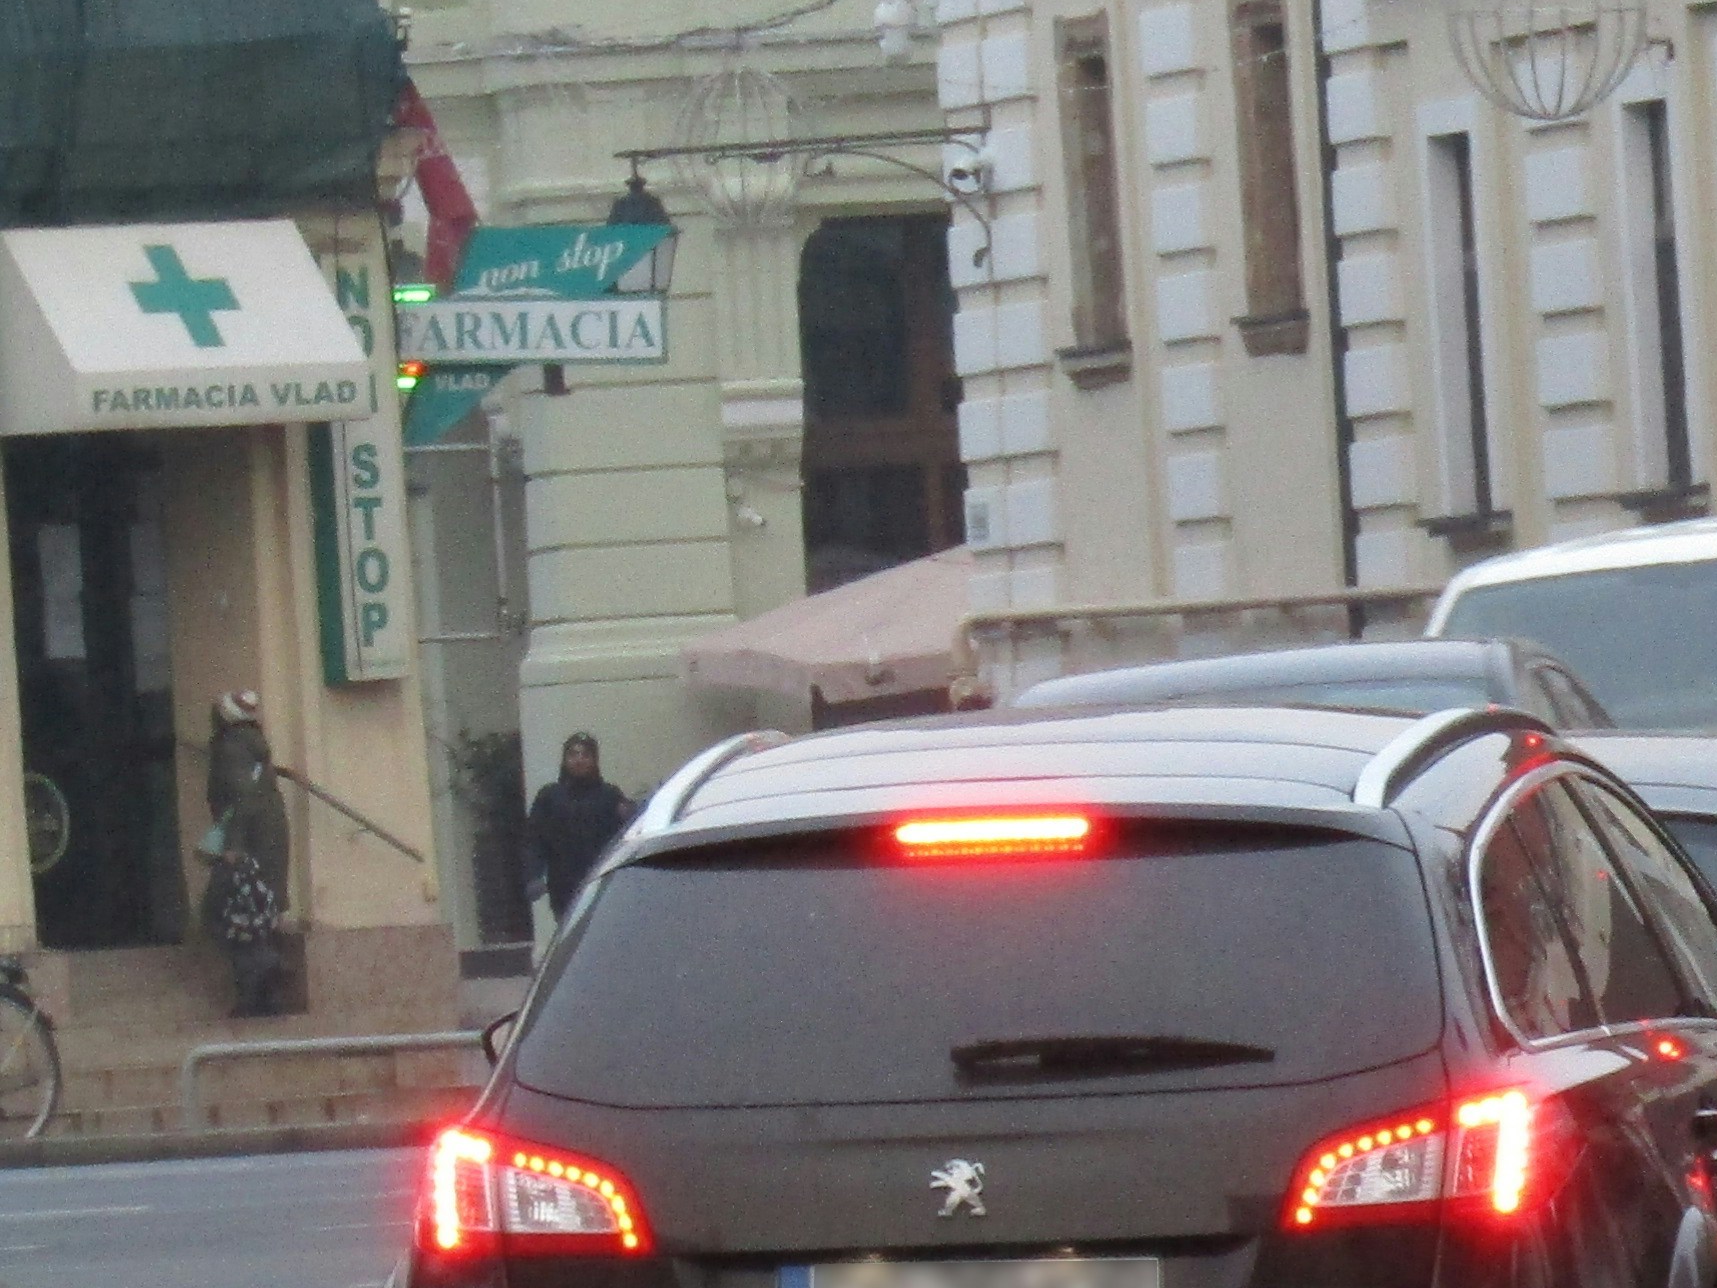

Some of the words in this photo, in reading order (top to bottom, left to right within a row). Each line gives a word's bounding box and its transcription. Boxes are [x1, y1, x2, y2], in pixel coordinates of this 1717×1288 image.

[476, 259, 538, 289] non
[554, 231, 626, 281] stop
[92, 383, 260, 413] FARMACIA
[269, 379, 358, 408] VLAD
[351, 441, 391, 649] STOP
